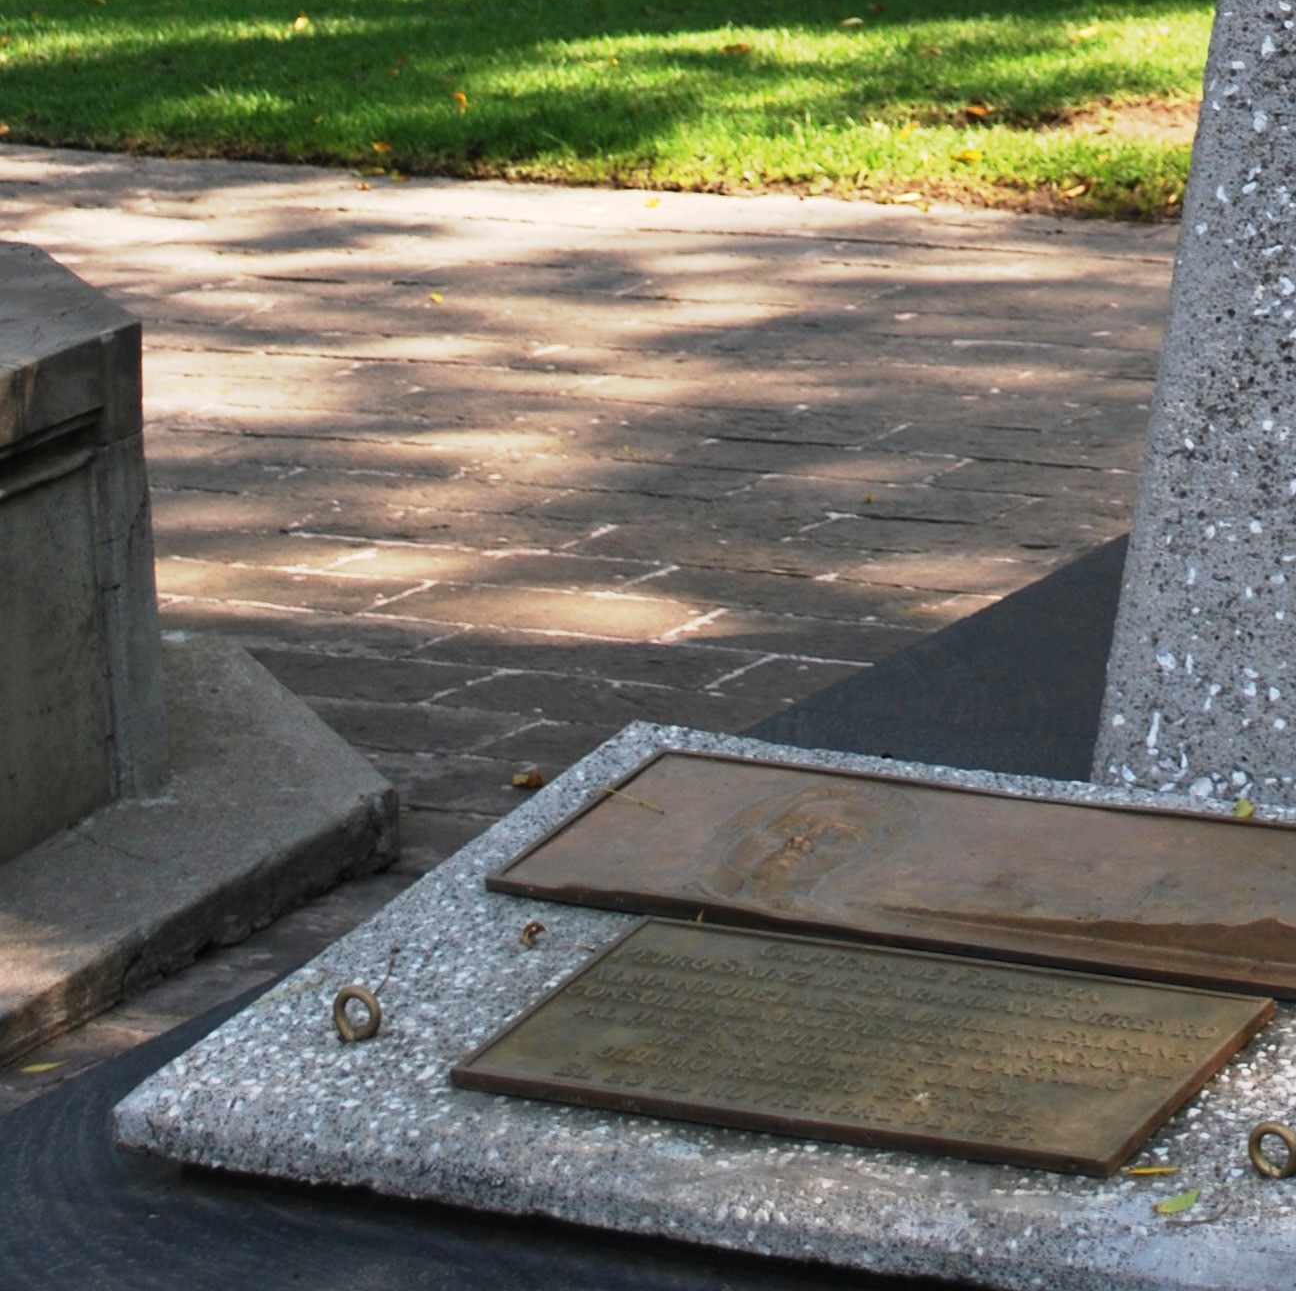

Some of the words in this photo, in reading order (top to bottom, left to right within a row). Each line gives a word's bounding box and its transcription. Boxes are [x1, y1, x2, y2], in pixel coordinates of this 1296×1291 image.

[563, 981, 719, 1014] CONSOLIDA
[608, 945, 714, 971] PEDRO
[704, 958, 817, 986] SAINZ
[814, 974, 860, 991] DE
[1038, 1001, 1224, 1041] BORREYRO
[754, 942, 901, 975] CAPITAN
[902, 964, 946, 982] DE
[947, 968, 1106, 1004] FRAGATA
[572, 1002, 619, 1020] AL
[625, 1009, 733, 1035] HACER
[731, 1023, 914, 1061] CAPITULAR
[918, 1050, 956, 1068] EL
[968, 1057, 1130, 1092] CASTILLO
[646, 1032, 692, 1049] DE
[697, 1039, 771, 1061] SAN
[774, 1049, 868, 1075] JUAN
[869, 1063, 915, 1081] DE
[1024, 1026, 1197, 1063] MEXICANA
[555, 1061, 594, 1079] EL
[652, 1075, 700, 1094] DE
[904, 1110, 953, 1130] DE
[713, 1061, 867, 1094] REDUCTO
